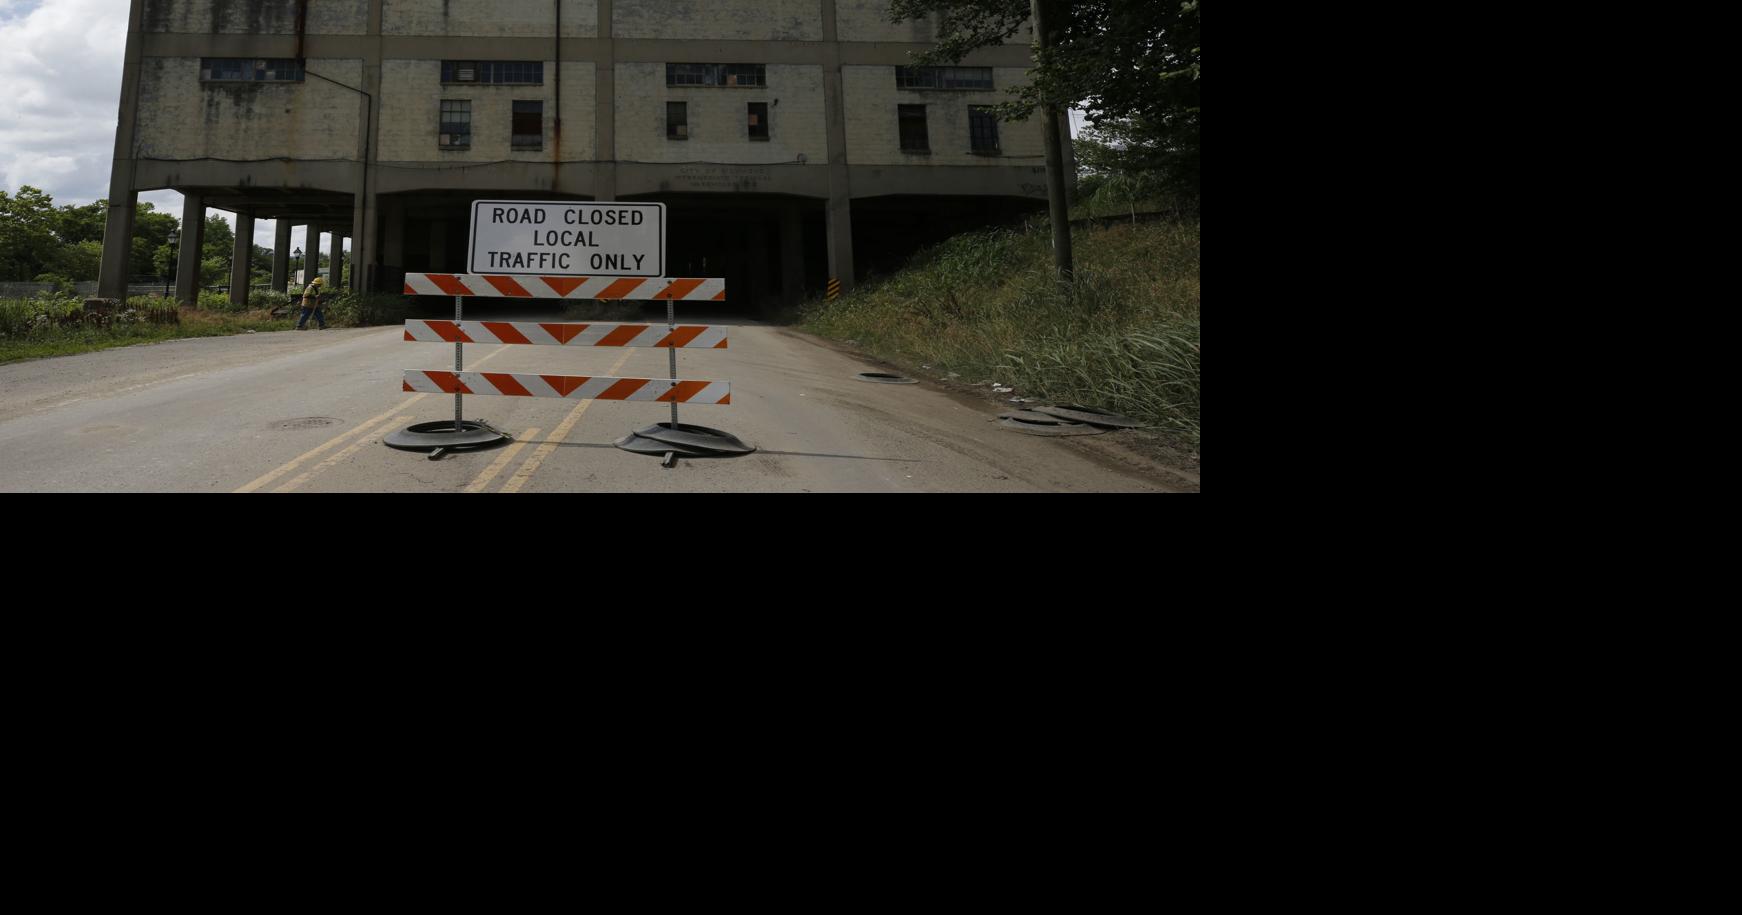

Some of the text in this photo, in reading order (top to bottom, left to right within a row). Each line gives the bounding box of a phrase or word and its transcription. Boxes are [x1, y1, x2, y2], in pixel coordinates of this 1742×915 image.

[492, 207, 643, 226] ROAD CLOSED
[533, 230, 599, 247] LOCAL
[488, 251, 645, 271] TRAFFIC ONLY
